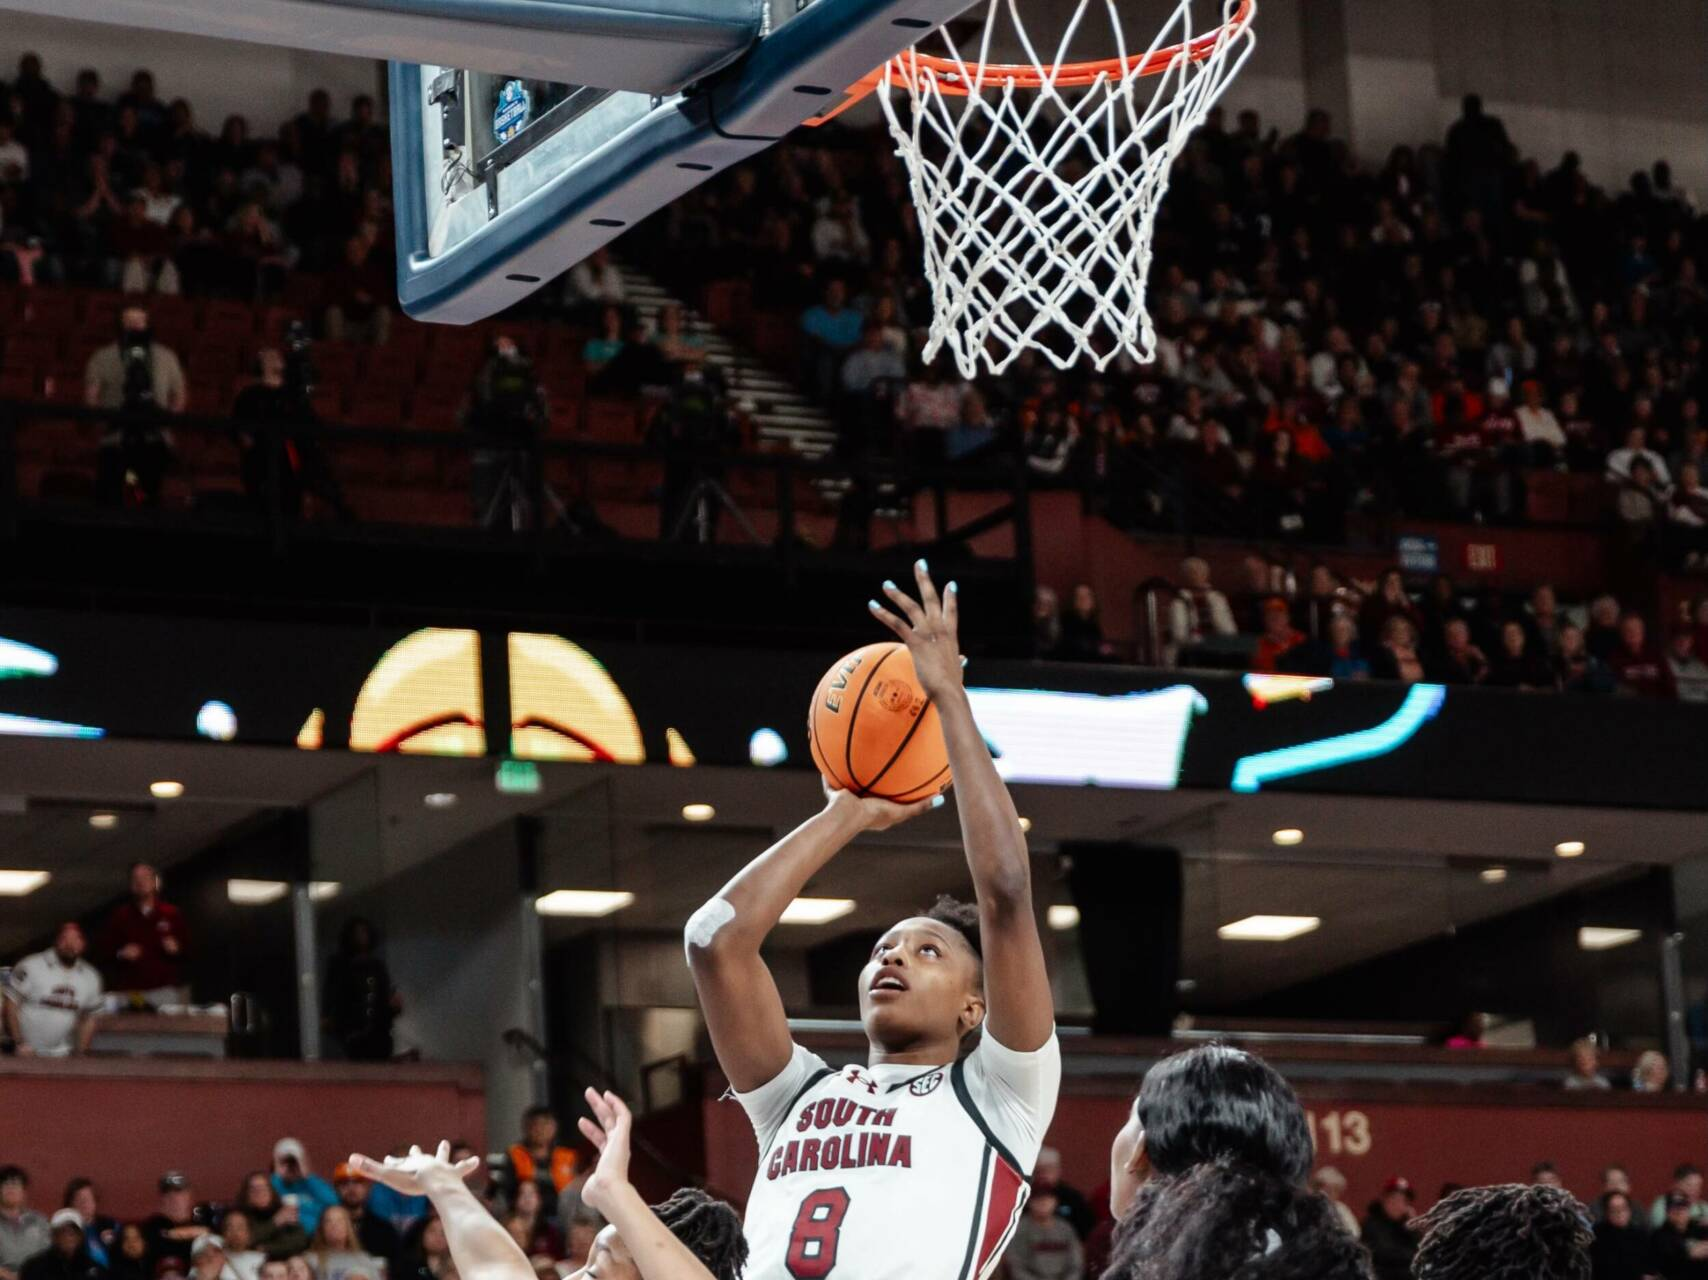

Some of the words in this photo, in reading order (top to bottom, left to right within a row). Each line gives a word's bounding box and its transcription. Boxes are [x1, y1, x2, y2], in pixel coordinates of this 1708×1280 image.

[911, 1074, 942, 1095] SEC
[796, 1097, 898, 1133] SOUTH
[766, 1132, 912, 1181] CAROLINA
